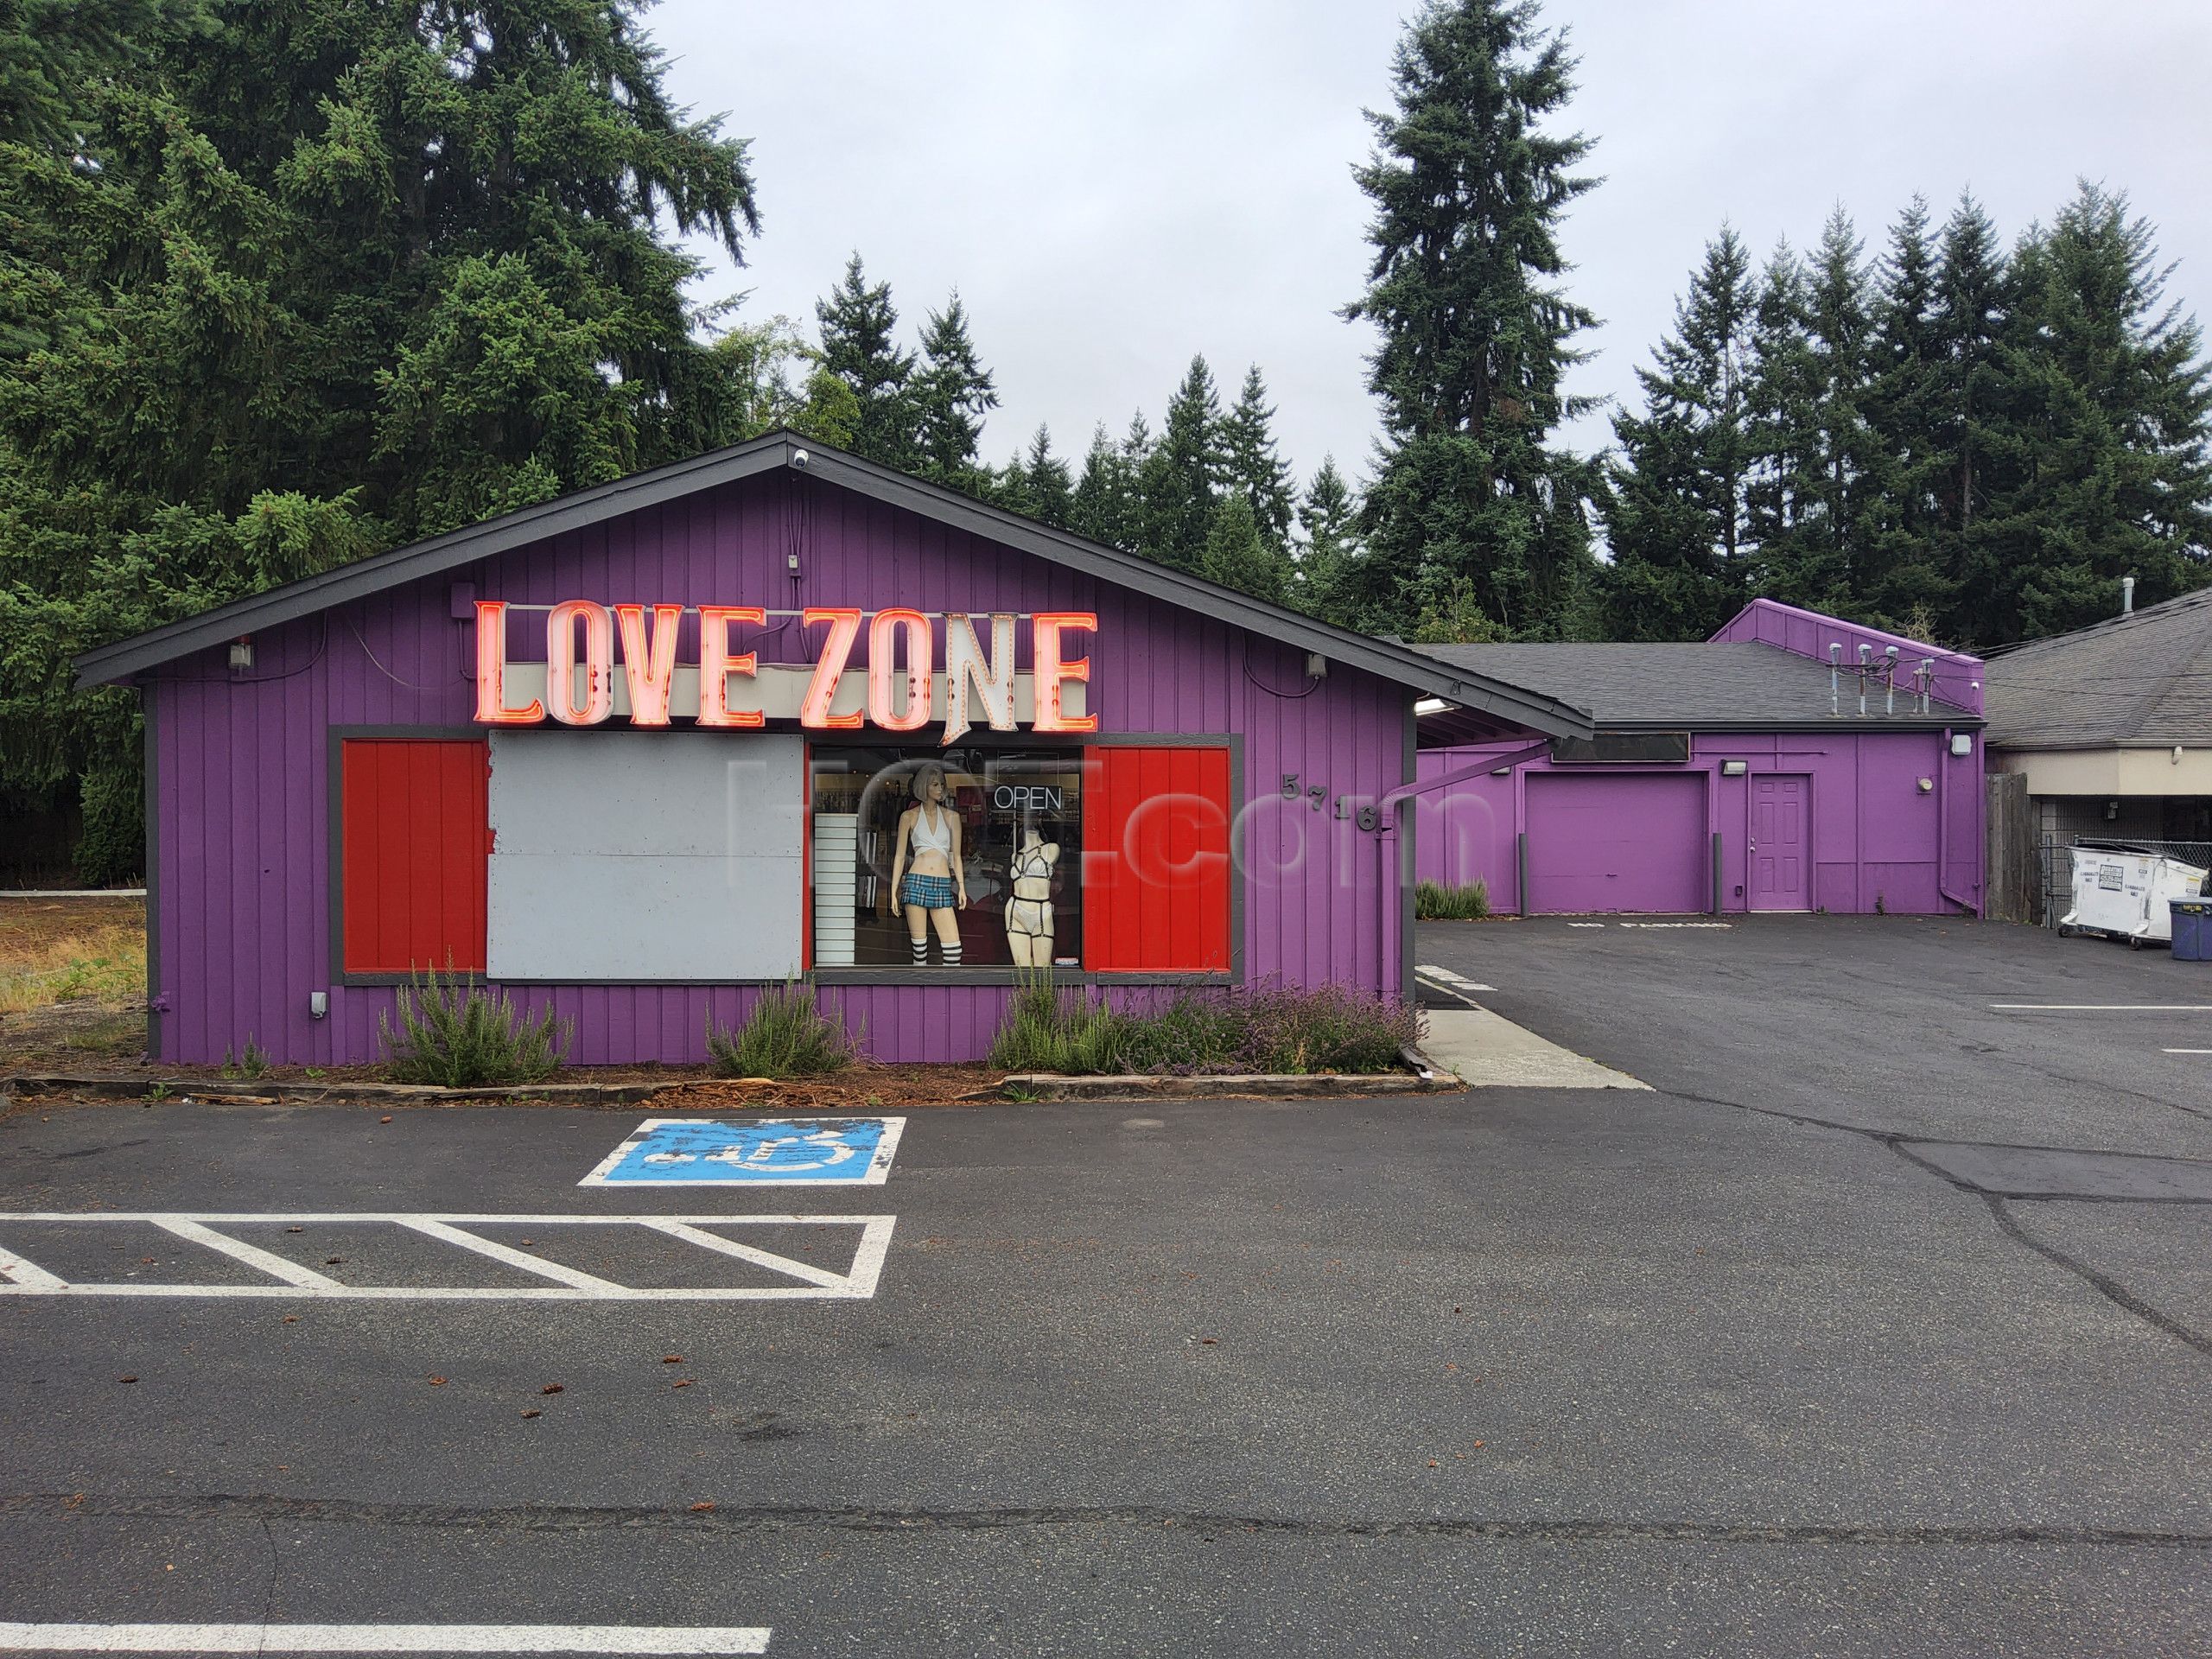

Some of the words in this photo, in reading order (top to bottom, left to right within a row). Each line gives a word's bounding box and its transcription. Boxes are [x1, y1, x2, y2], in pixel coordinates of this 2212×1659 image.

[474, 600, 767, 728] LOVE
[800, 607, 1098, 748] ZONE
[994, 785, 1063, 810] OPEN
[1281, 773, 1378, 831] 5716
